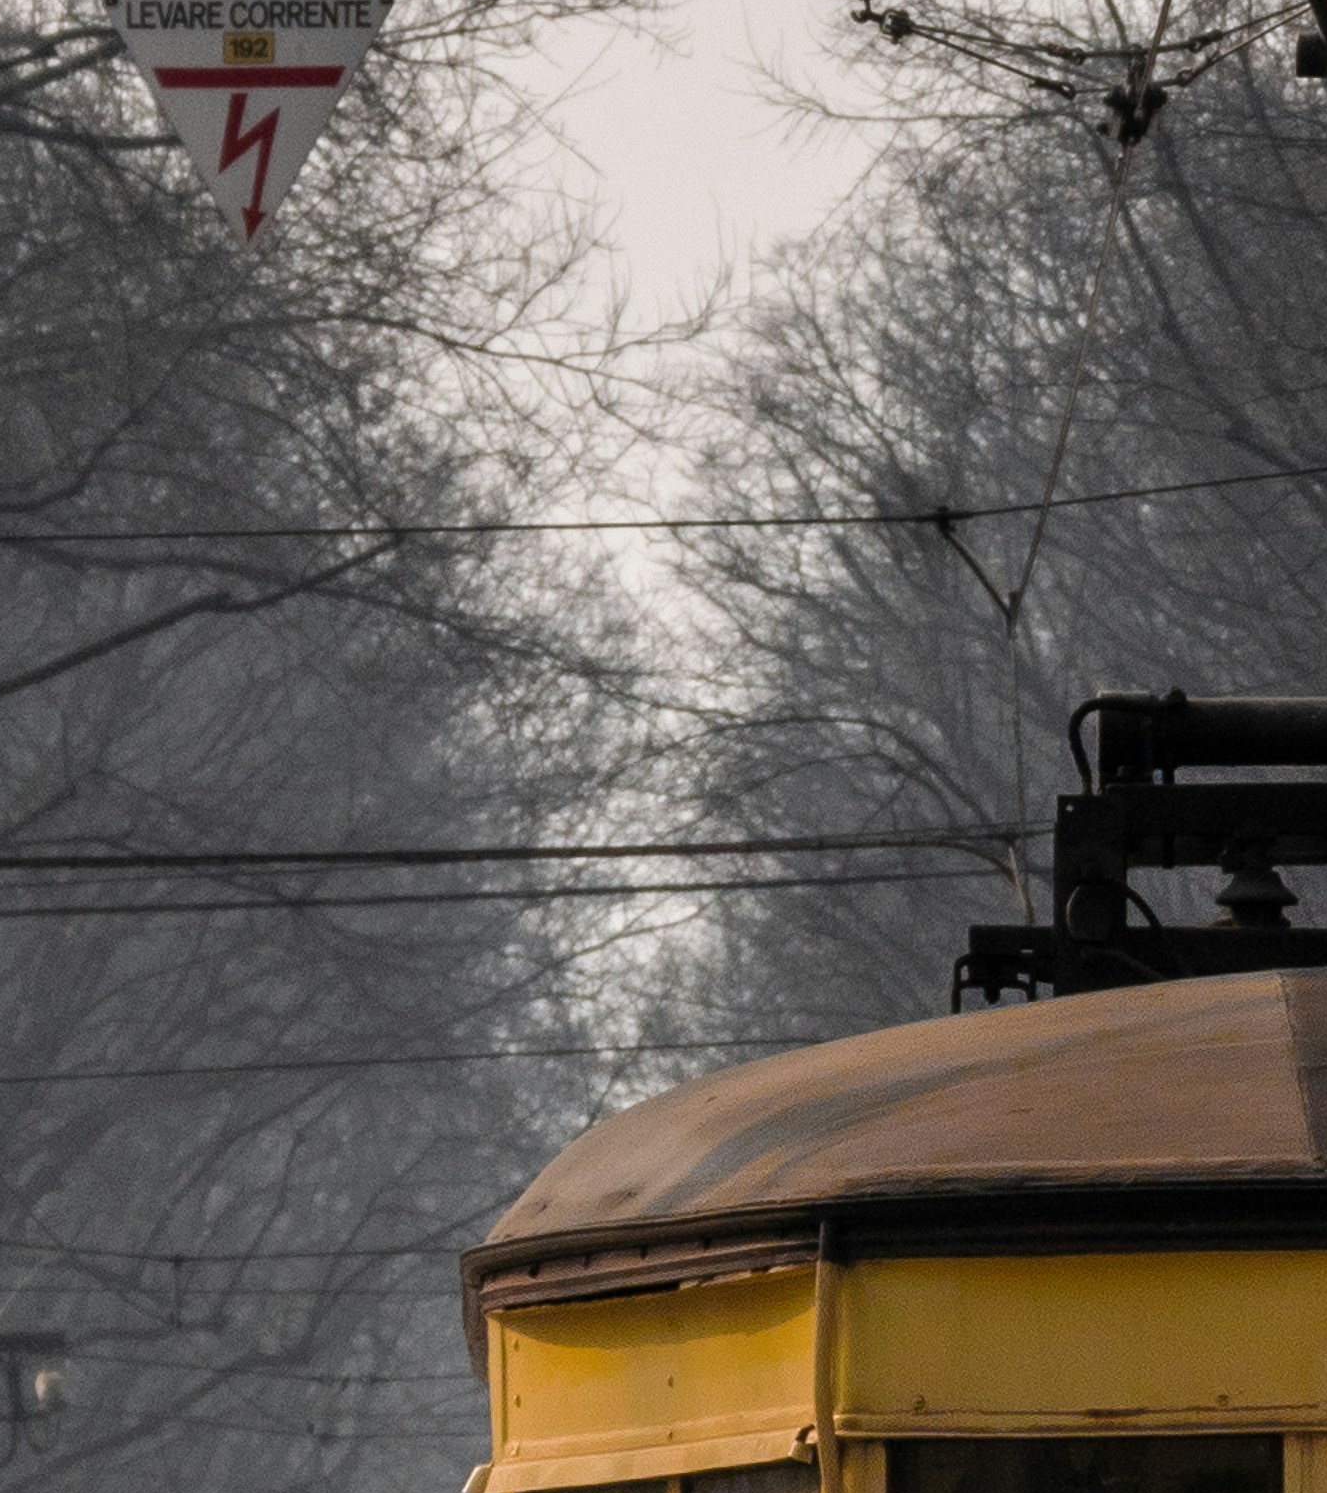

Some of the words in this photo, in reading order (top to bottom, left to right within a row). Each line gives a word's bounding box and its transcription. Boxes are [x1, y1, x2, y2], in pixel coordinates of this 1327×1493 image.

[126, 1, 223, 29] LEVARE
[229, 0, 372, 29] CORRENTE
[230, 37, 268, 58] 192
